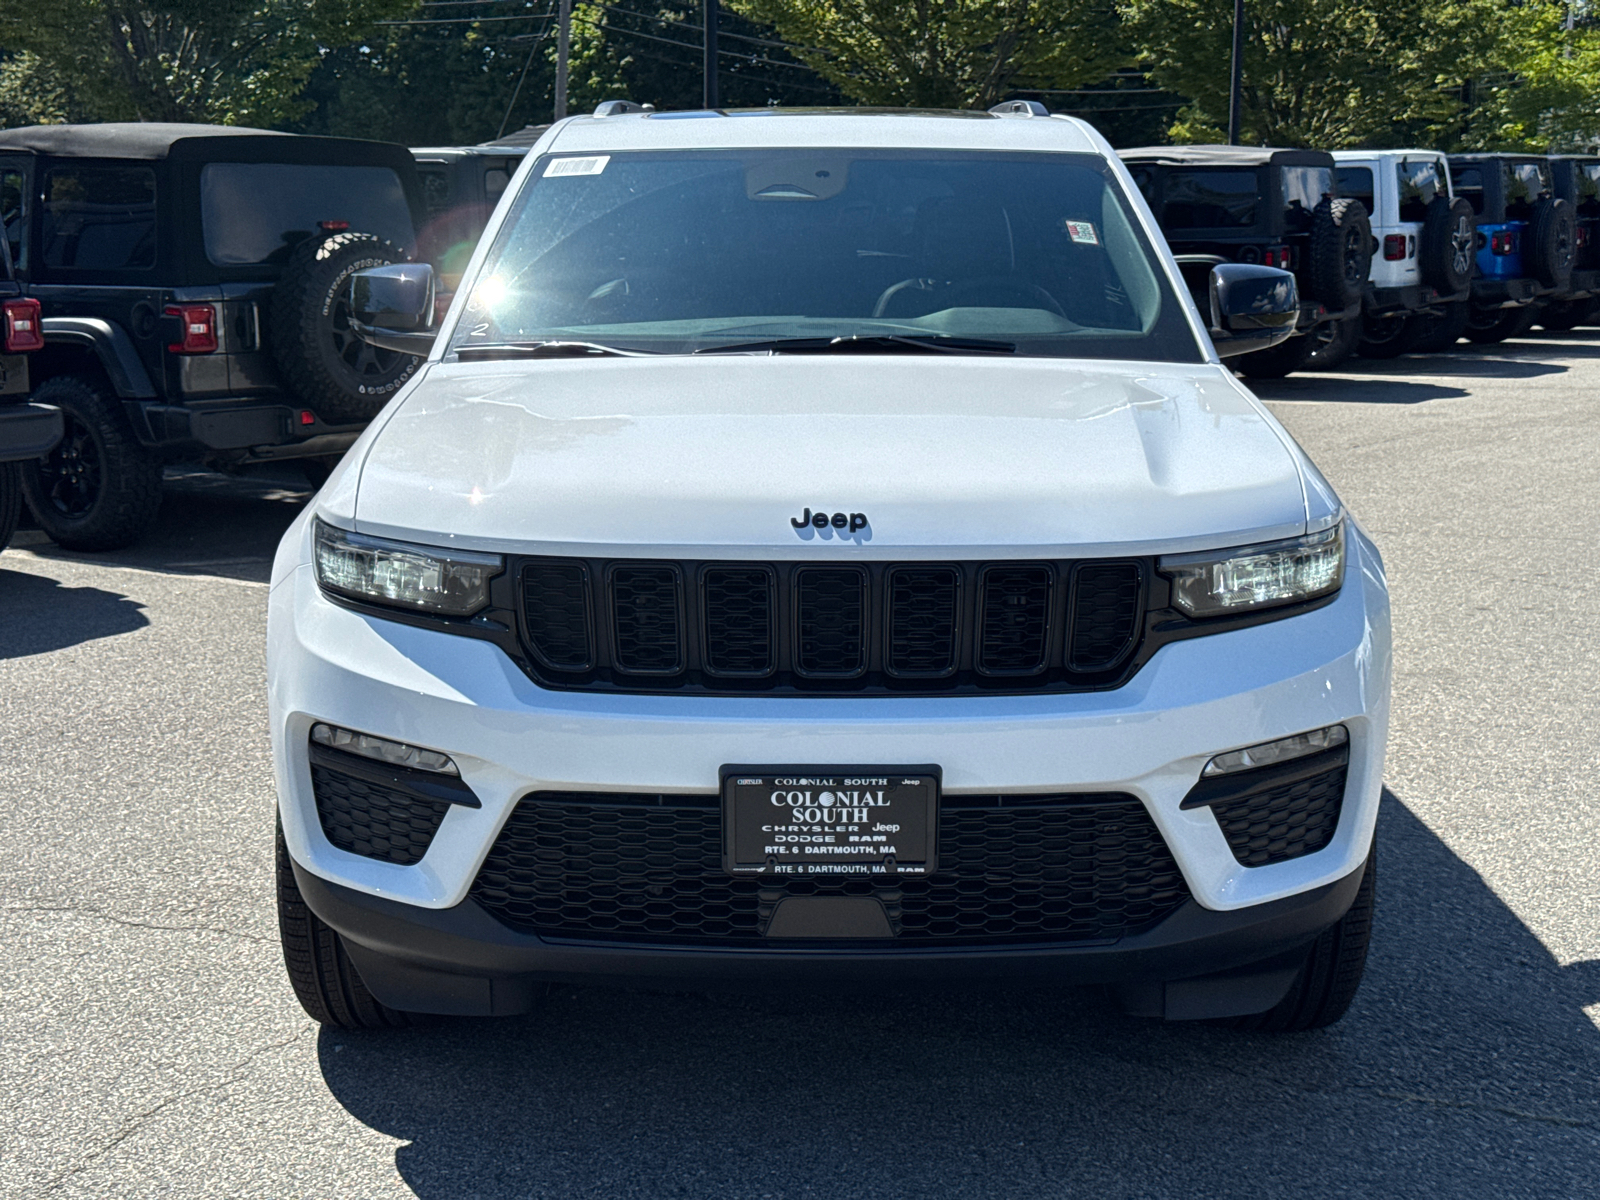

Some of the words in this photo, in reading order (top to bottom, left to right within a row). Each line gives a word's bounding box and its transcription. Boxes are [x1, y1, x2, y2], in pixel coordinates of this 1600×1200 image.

[790, 507, 868, 533] Jeep
[774, 778, 836, 786] COLONIAL
[844, 778, 888, 786] SOUTH
[770, 791, 891, 807] COLONIAL
[792, 807, 869, 823] SOUTH
[872, 822, 900, 833] Jeep
[764, 846, 789, 854] RTE.
[792, 846, 799, 854] 6
[805, 846, 877, 855] DARTMOUTH,
[879, 846, 896, 854] MA
[774, 865, 796, 873] RTE.
[797, 865, 804, 873] 6
[808, 865, 870, 874] DARTMOUTH,
[872, 865, 887, 873] MA
